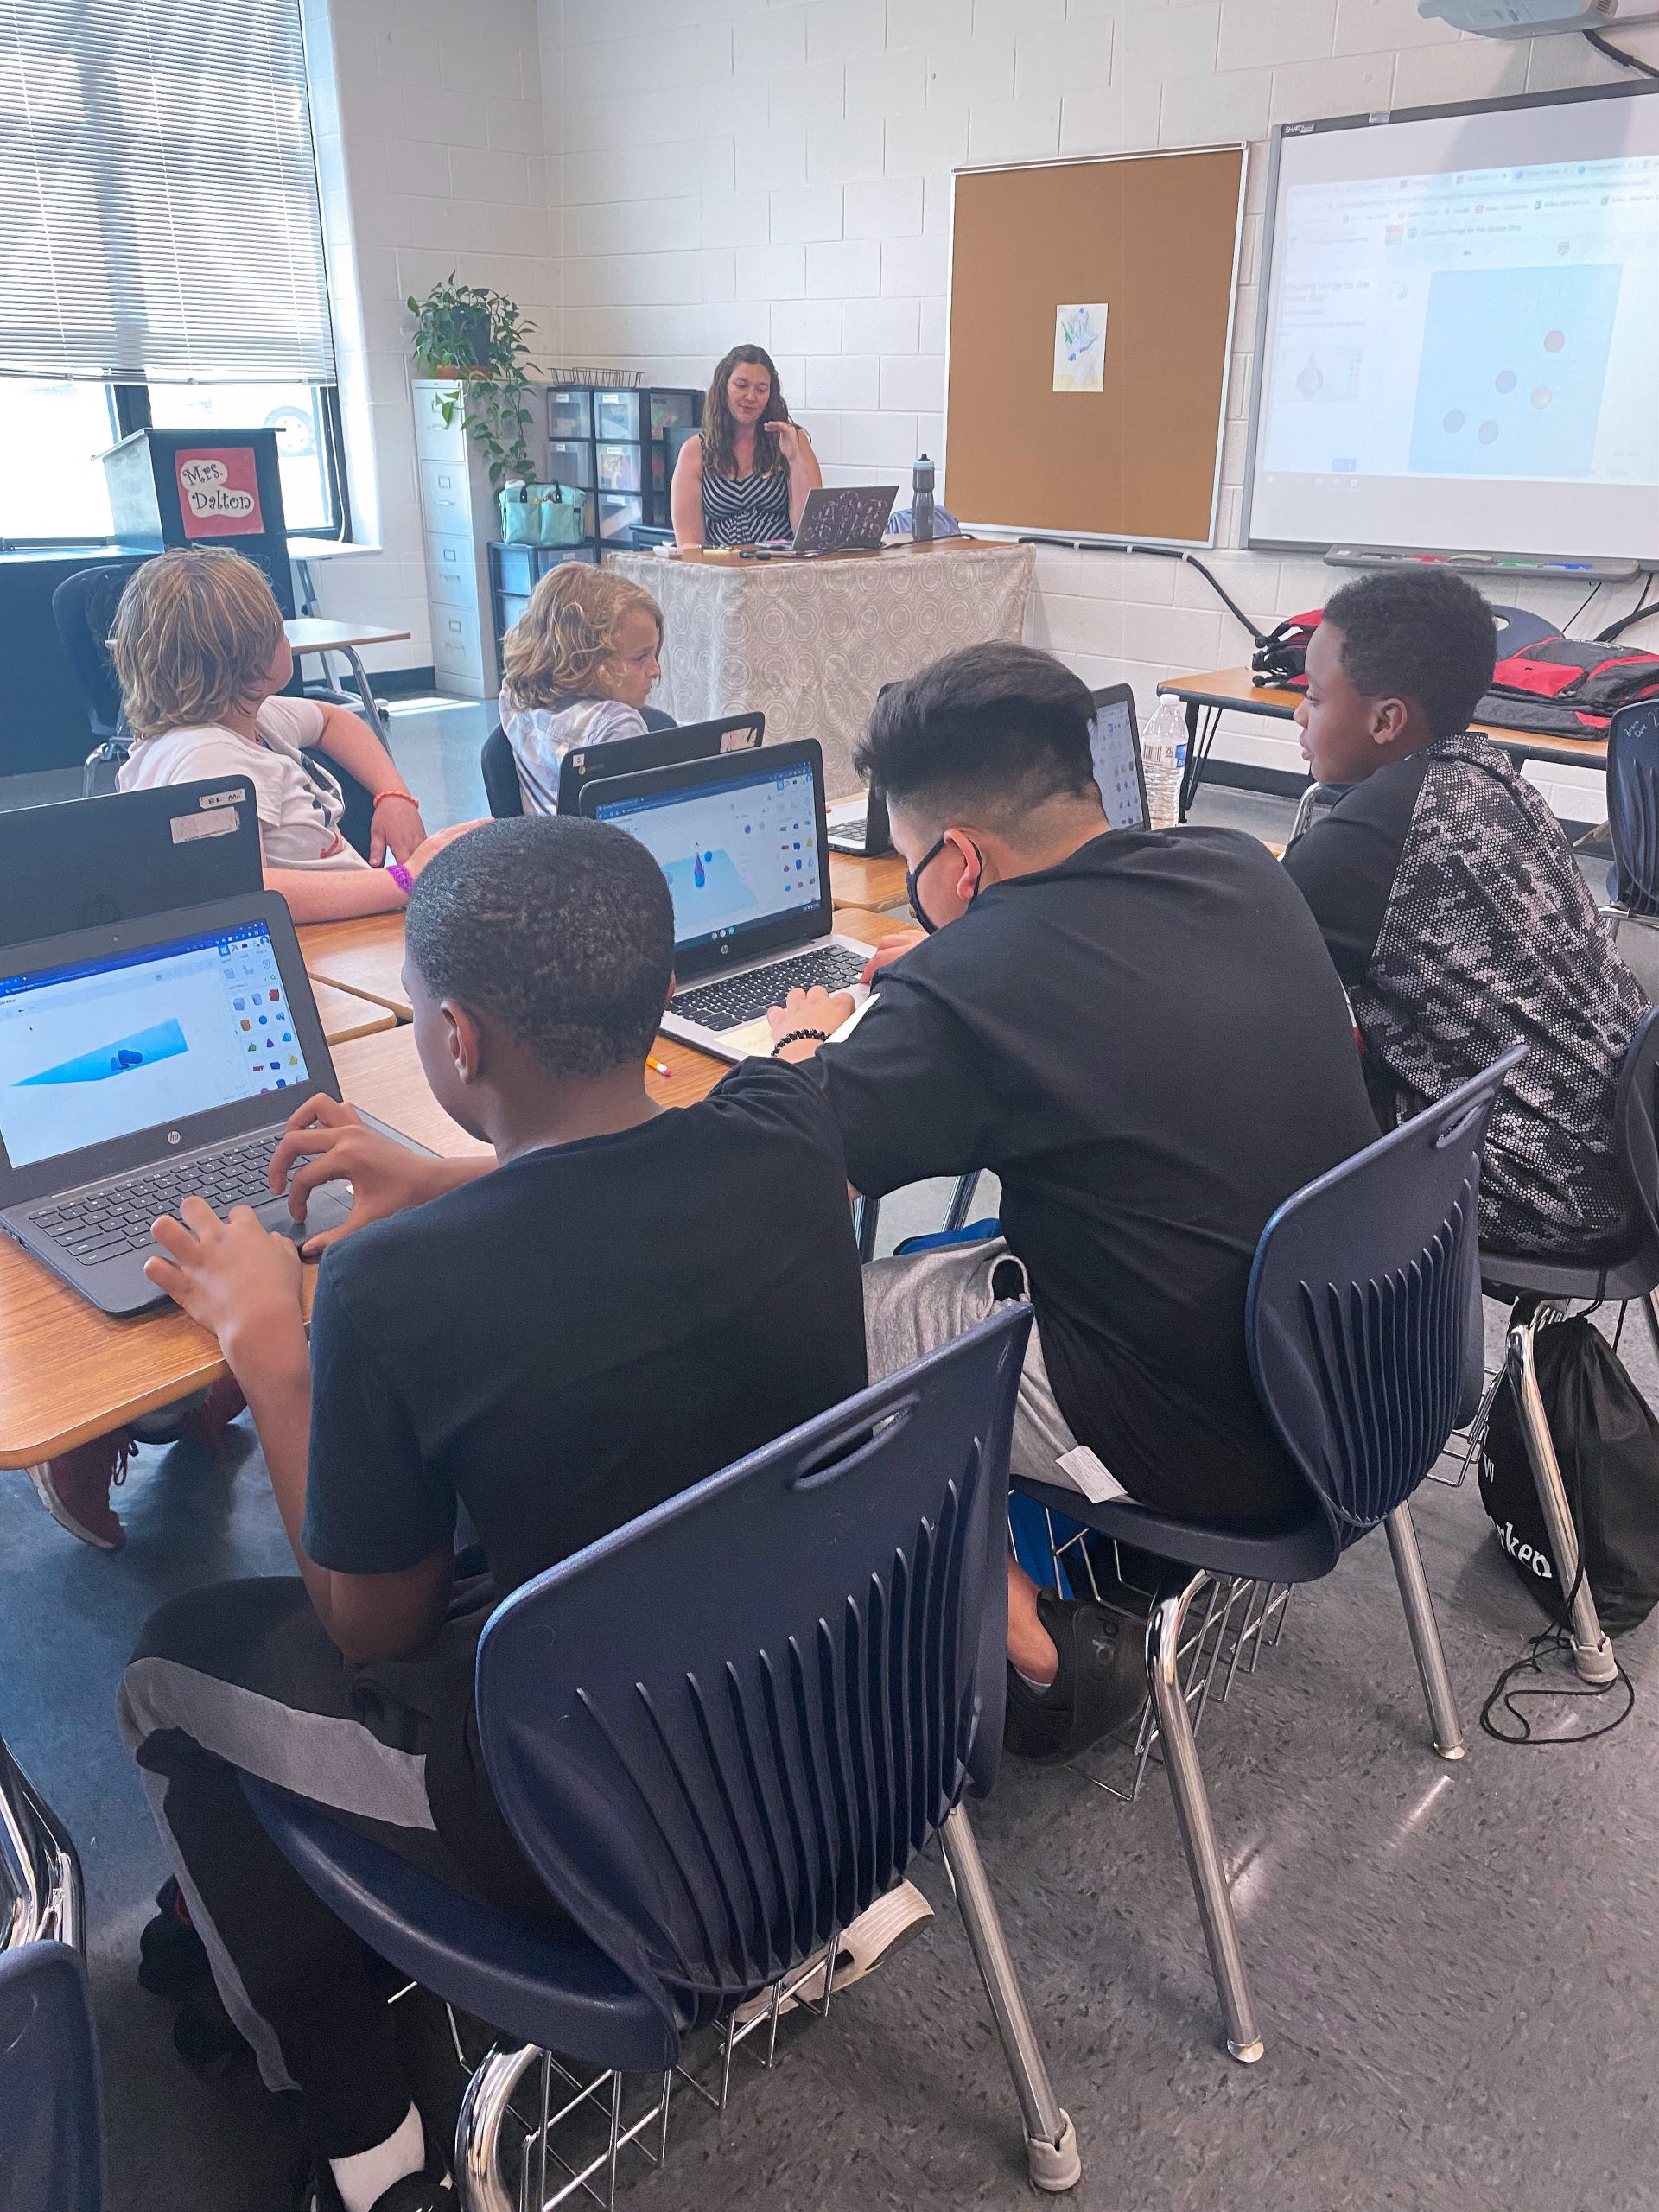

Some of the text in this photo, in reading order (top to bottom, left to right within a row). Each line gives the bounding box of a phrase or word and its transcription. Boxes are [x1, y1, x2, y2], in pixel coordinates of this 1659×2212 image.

[182, 464, 223, 486] Mrs.
[192, 490, 251, 510] Dalton
[168, 1130, 180, 1145] hp
